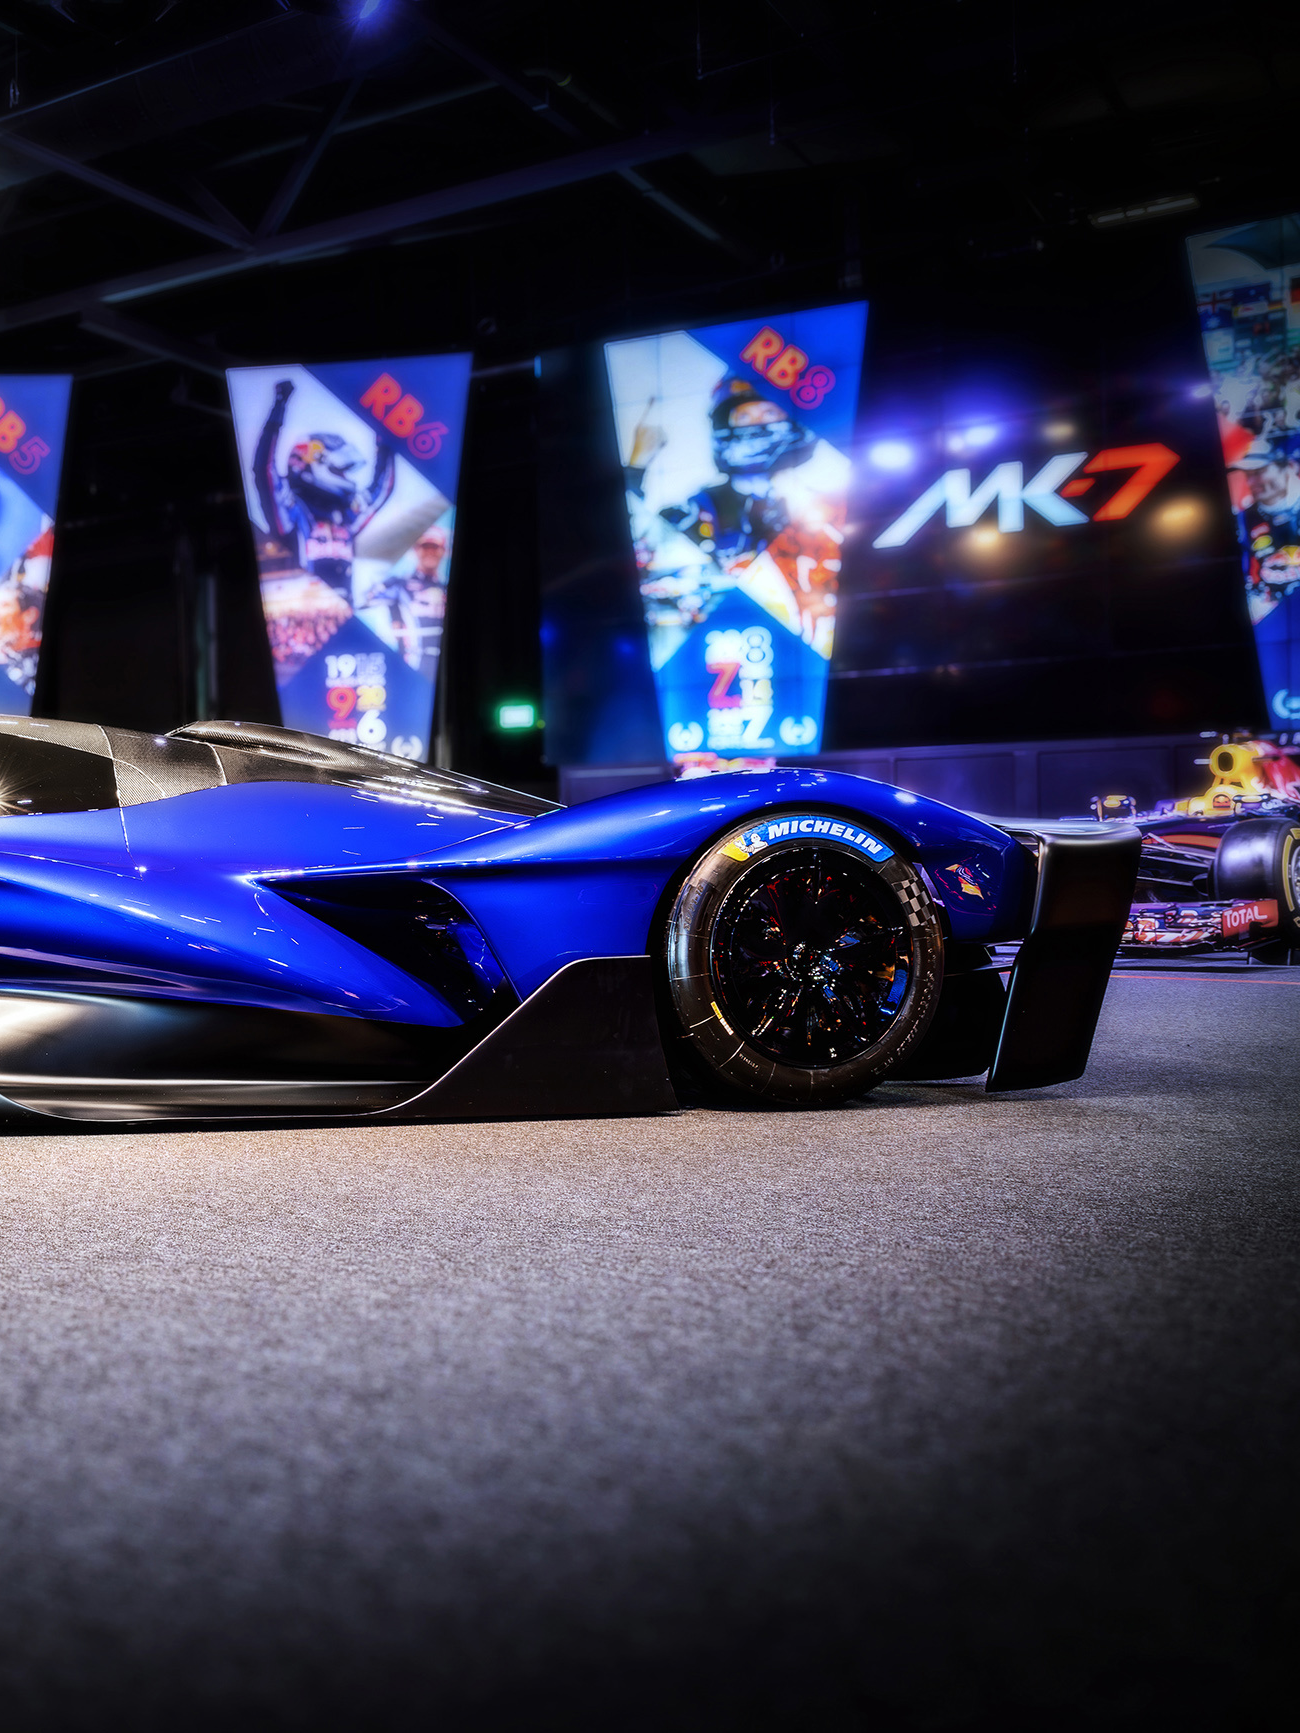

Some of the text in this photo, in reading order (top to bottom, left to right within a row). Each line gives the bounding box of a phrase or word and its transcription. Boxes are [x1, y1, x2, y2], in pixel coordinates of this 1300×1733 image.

[738, 324, 837, 411] RB8
[359, 372, 448, 460] RB6
[357, 709, 387, 744] 6
[768, 819, 883, 855] MICHELIN
[1224, 905, 1268, 929] TOTAL
